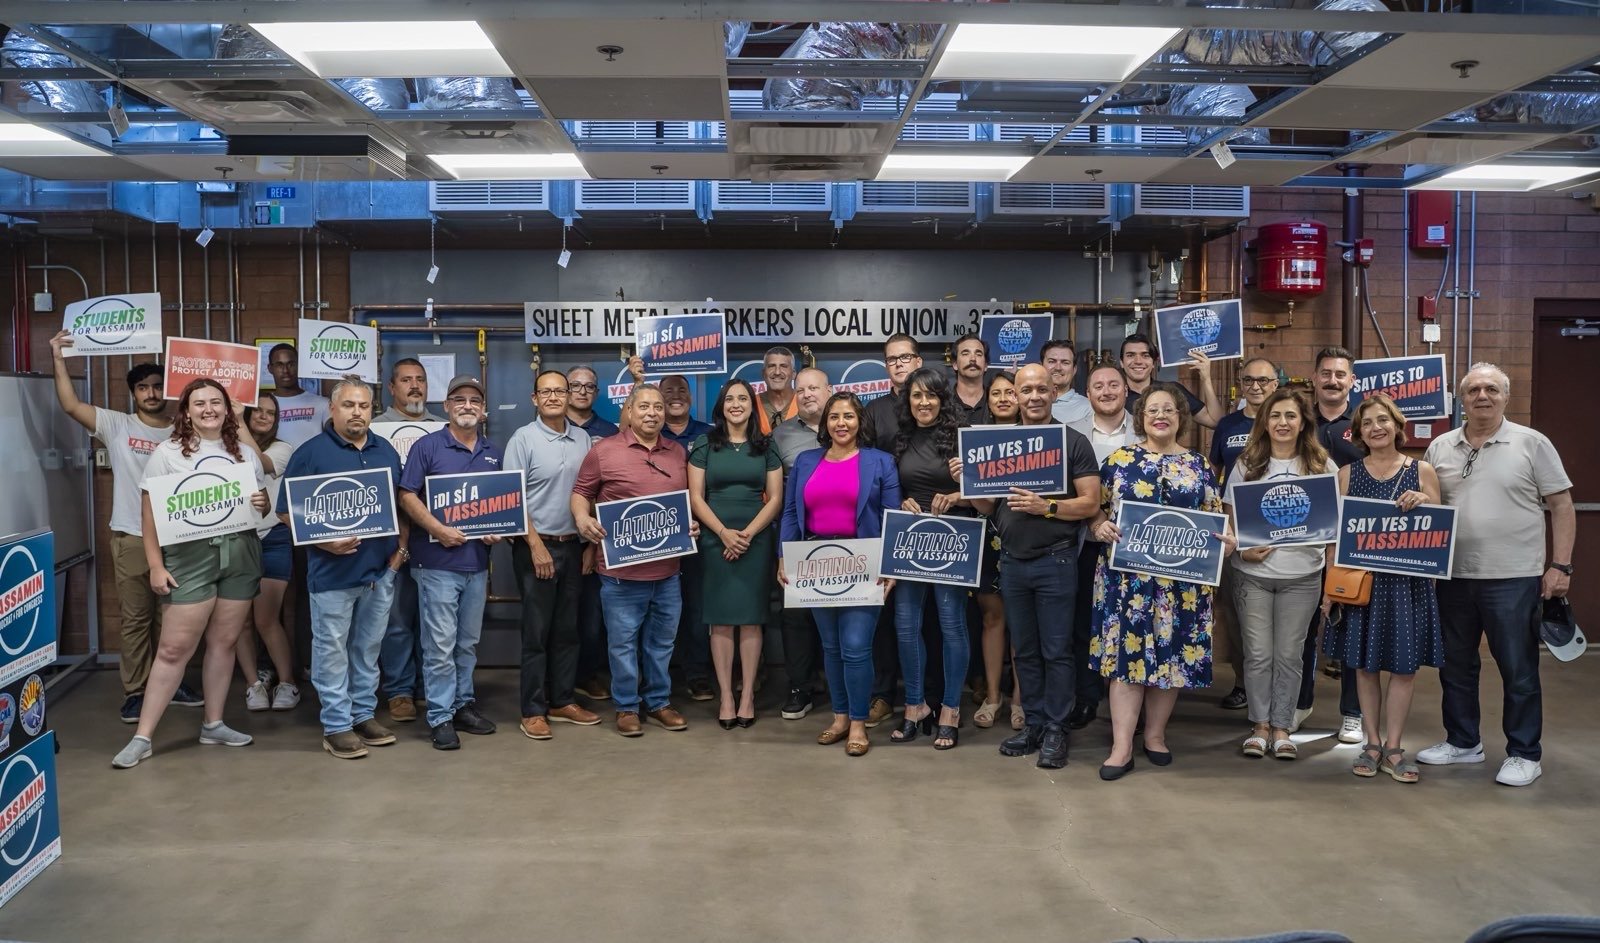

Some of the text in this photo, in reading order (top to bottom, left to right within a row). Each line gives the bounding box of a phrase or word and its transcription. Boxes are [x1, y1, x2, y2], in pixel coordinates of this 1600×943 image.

[271, 188, 291, 198] REF-1
[73, 307, 145, 329] STUDENTS
[532, 308, 594, 338] SHEET
[604, 308, 668, 336] MET
[683, 308, 794, 337] RKERS
[804, 308, 872, 336] LOCAL
[880, 308, 948, 336] UNION
[1180, 320, 1221, 329] CLIMATE
[72, 322, 146, 336] FOR YASSAMIN
[642, 323, 684, 346] ¡DI SÍ A
[1181, 326, 1222, 336] ACTION
[310, 338, 367, 353] STUDENTS
[329, 352, 367, 360] YASSAMIN
[651, 332, 721, 360] YASSAMIN!
[172, 356, 217, 369] PROTECT
[172, 366, 254, 381] PROTECT ABORTION
[1353, 366, 1424, 393] SAY YES TO
[280, 408, 312, 418] SAMIN
[968, 436, 1044, 464] SAY YES TO
[978, 448, 1061, 480] YASSAMIN!
[166, 480, 241, 513] STUDENTS
[304, 485, 378, 517] LATINOS
[434, 481, 479, 510] ¡DI SÍ A
[1261, 497, 1311, 508] CLIMATE
[168, 497, 244, 522] FOR YASSAMIN
[304, 504, 382, 525] CON YASSAMIN
[443, 491, 521, 524] YASSAMIN!
[1262, 504, 1311, 518] ACTION
[613, 507, 678, 540] LATINOS
[1265, 514, 1309, 528] NOW
[1271, 526, 1306, 537] YASSAMIN
[1346, 515, 1432, 533] SAY YES TO
[614, 525, 681, 548] CON YASSAMIN
[894, 532, 969, 552] LATINOS
[1129, 524, 1210, 549] LATINOS
[1356, 530, 1450, 551] YASSAMIN!
[893, 550, 969, 562] CON YASSAMIN
[1127, 543, 1210, 558] CON YASSAMIN
[796, 554, 867, 580] LATINOS
[796, 574, 869, 588] CON YASSAMIN
[0, 574, 42, 614] ASSAMIN
[0, 776, 43, 833] ASSAMIN
